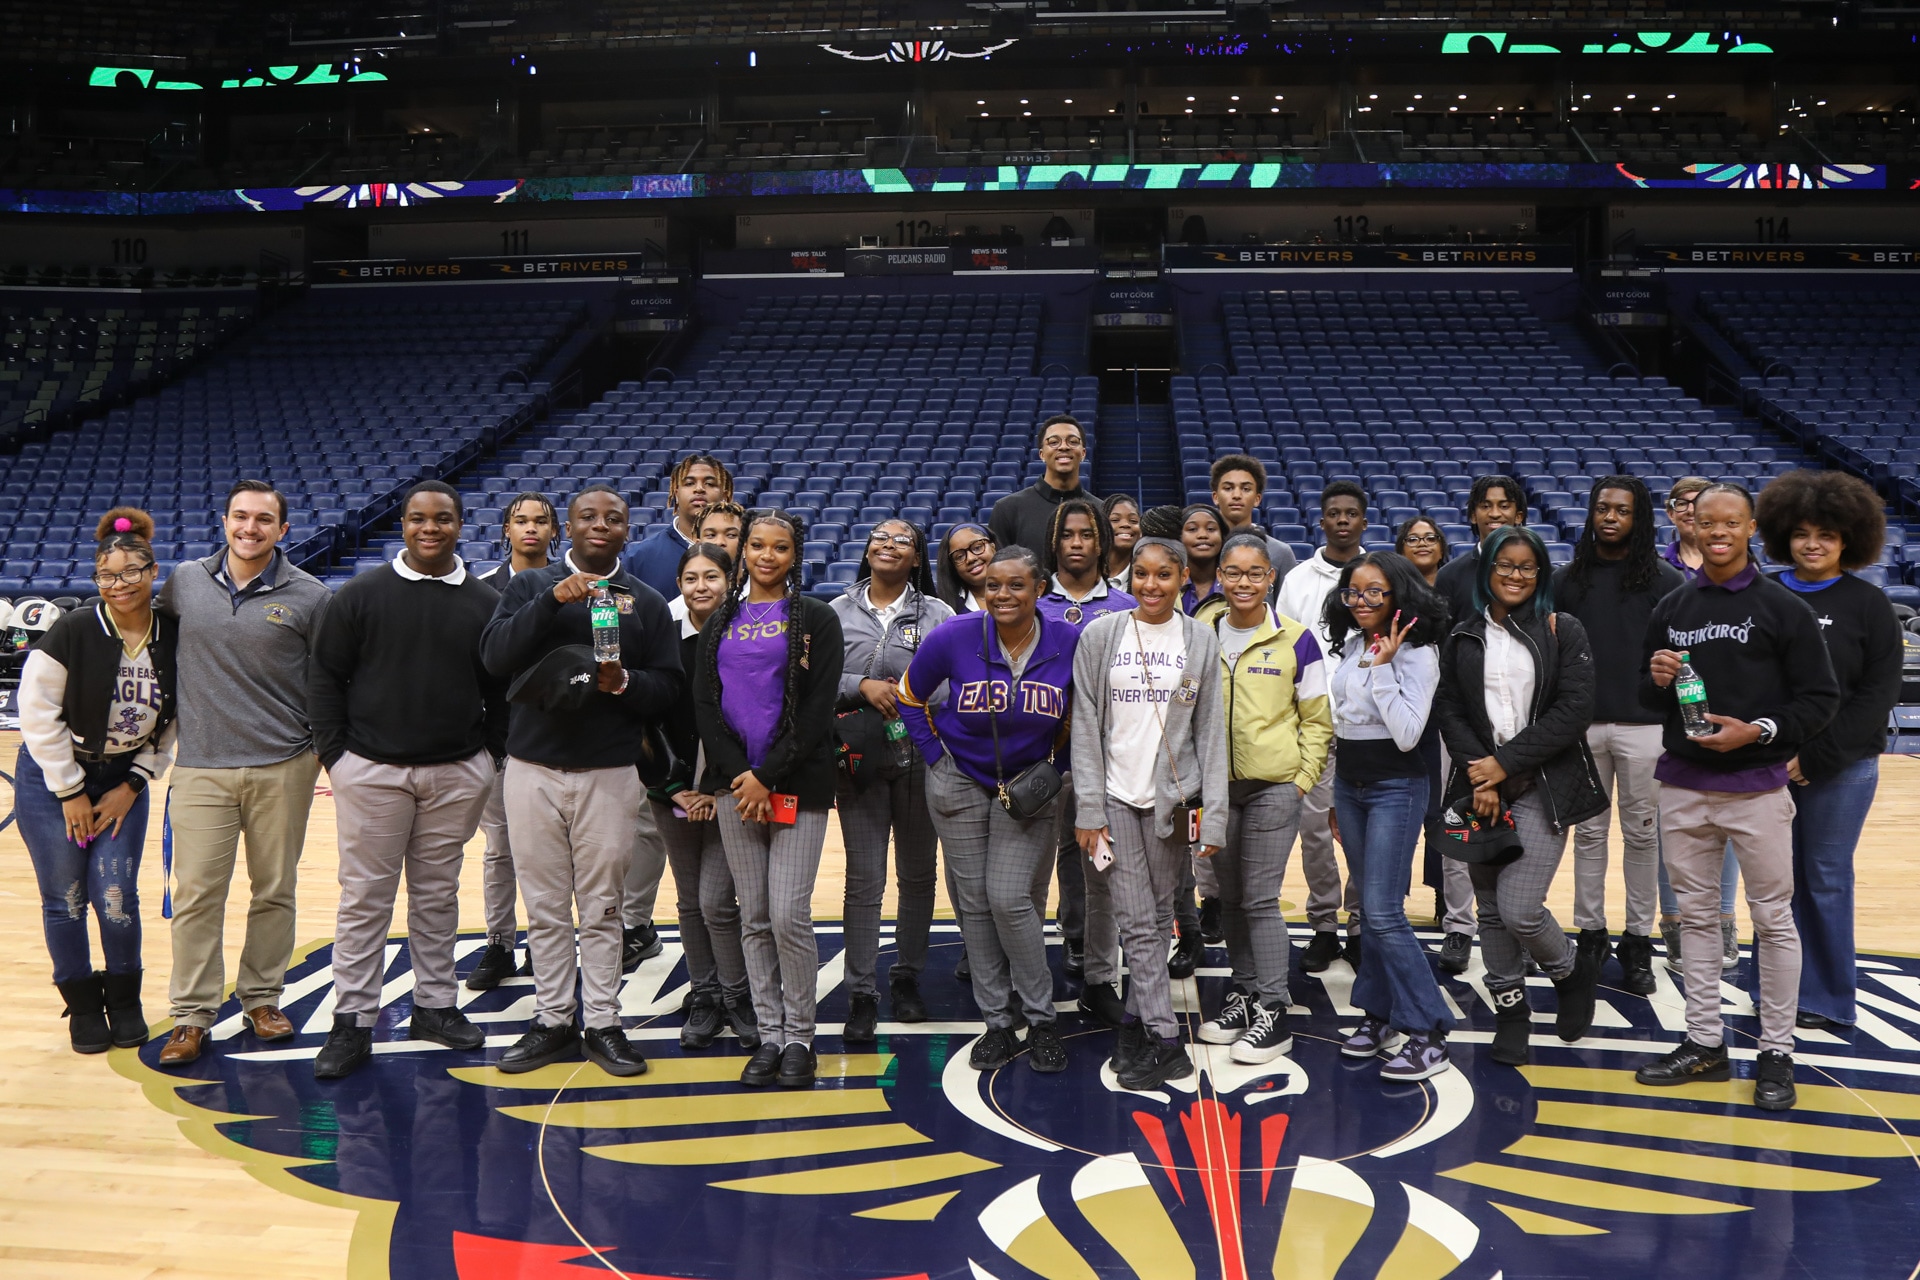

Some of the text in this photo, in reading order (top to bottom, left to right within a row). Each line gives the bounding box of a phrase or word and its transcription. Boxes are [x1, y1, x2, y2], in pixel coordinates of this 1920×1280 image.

[1079, 210, 1093, 221] 112
[1171, 209, 1184, 219] 113
[738, 216, 751, 226] 112
[1755, 217, 1791, 243] 114
[500, 229, 530, 255] 111
[111, 238, 148, 264] 110
[1239, 251, 1353, 262] BETRIVERS
[1422, 251, 1537, 262] BETRIVERS
[1691, 251, 1805, 262] BETRIVERS
[887, 253, 946, 264] PELICANS RADIO
[359, 264, 461, 277] BETRIVERS
[523, 260, 628, 273] BETRIVERS
[1110, 291, 1155, 299] GREY GOOSE
[630, 298, 648, 306] GREY
[1104, 315, 1122, 325] 112
[1144, 314, 1162, 325] 113
[591, 608, 615, 623] prite
[1135, 651, 1172, 667] CANAL
[1176, 655, 1187, 669] S
[117, 666, 157, 680] REN EAS
[112, 680, 161, 713] AGLE
[1493, 988, 1524, 1008] UGG
